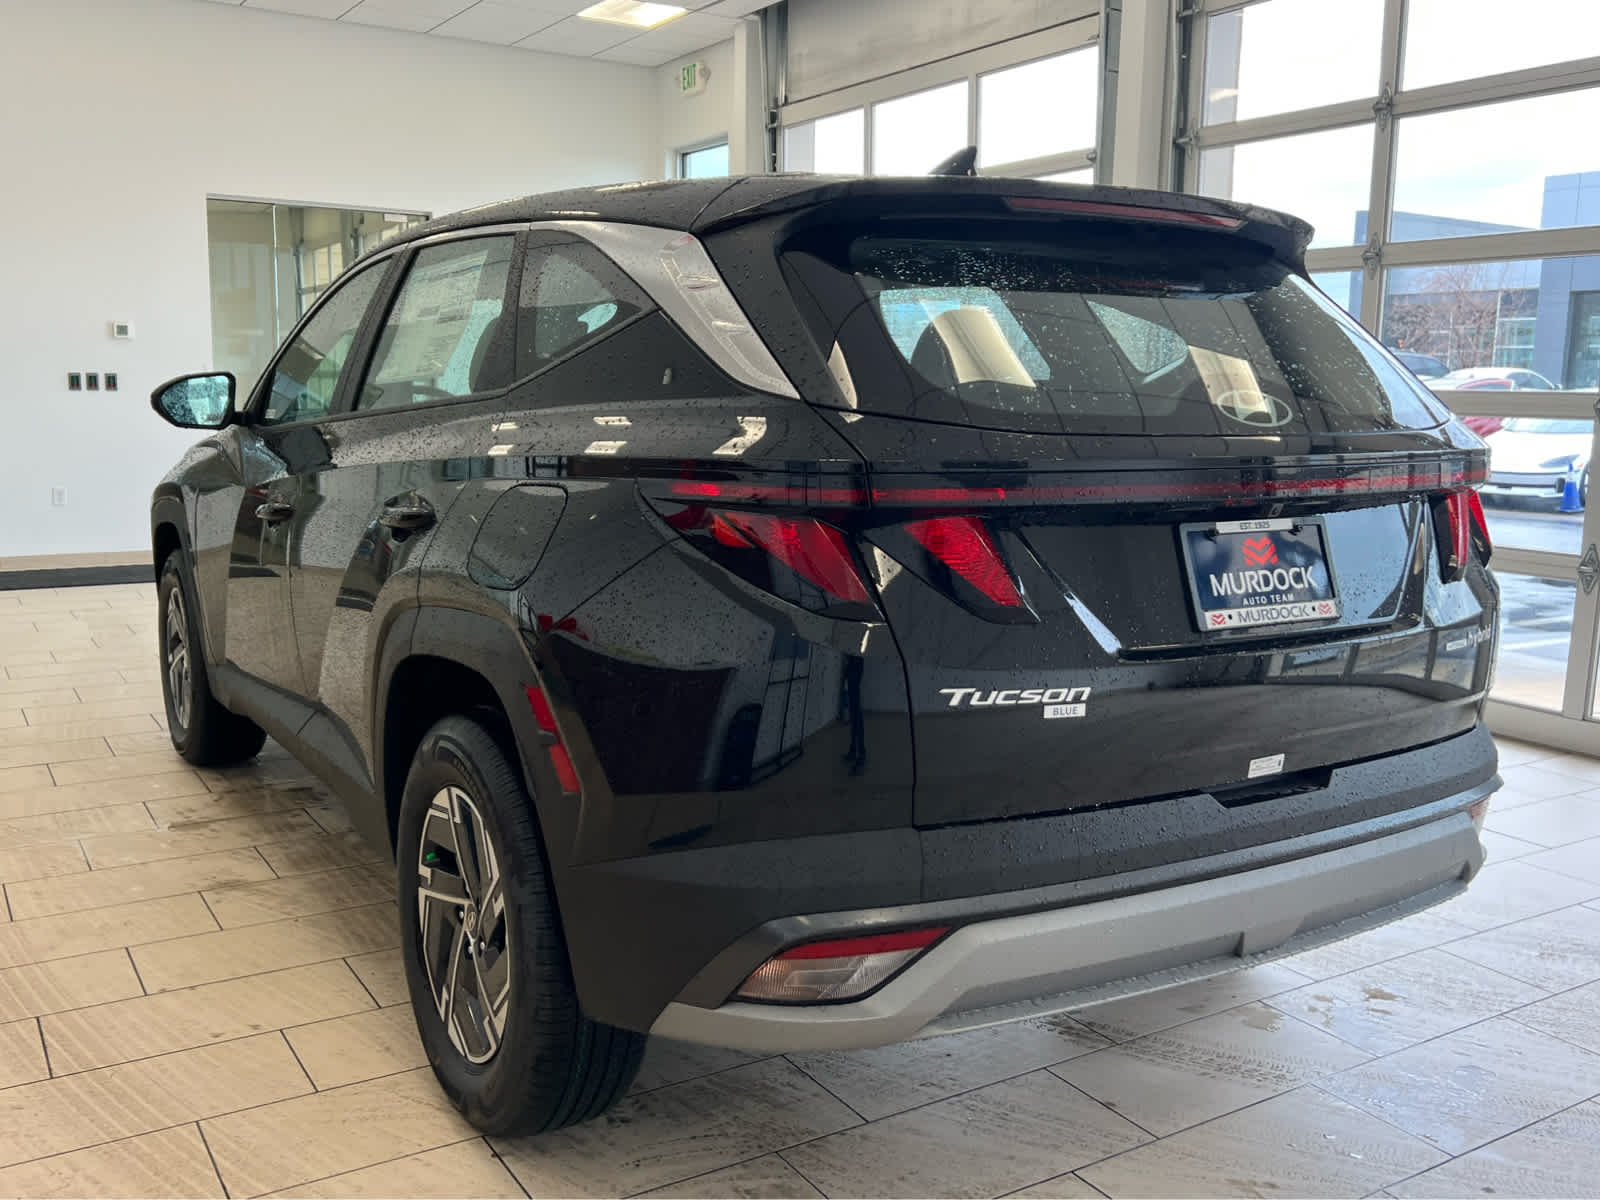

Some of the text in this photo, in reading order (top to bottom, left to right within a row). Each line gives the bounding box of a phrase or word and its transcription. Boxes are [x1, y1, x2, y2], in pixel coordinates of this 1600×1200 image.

[682, 63, 697, 91] EXIT
[1209, 566, 1318, 597] MURDOCK
[1242, 593, 1295, 606] AUTO TEAM
[1238, 604, 1310, 623] MURDOCK
[1053, 706, 1078, 716] BLUE
